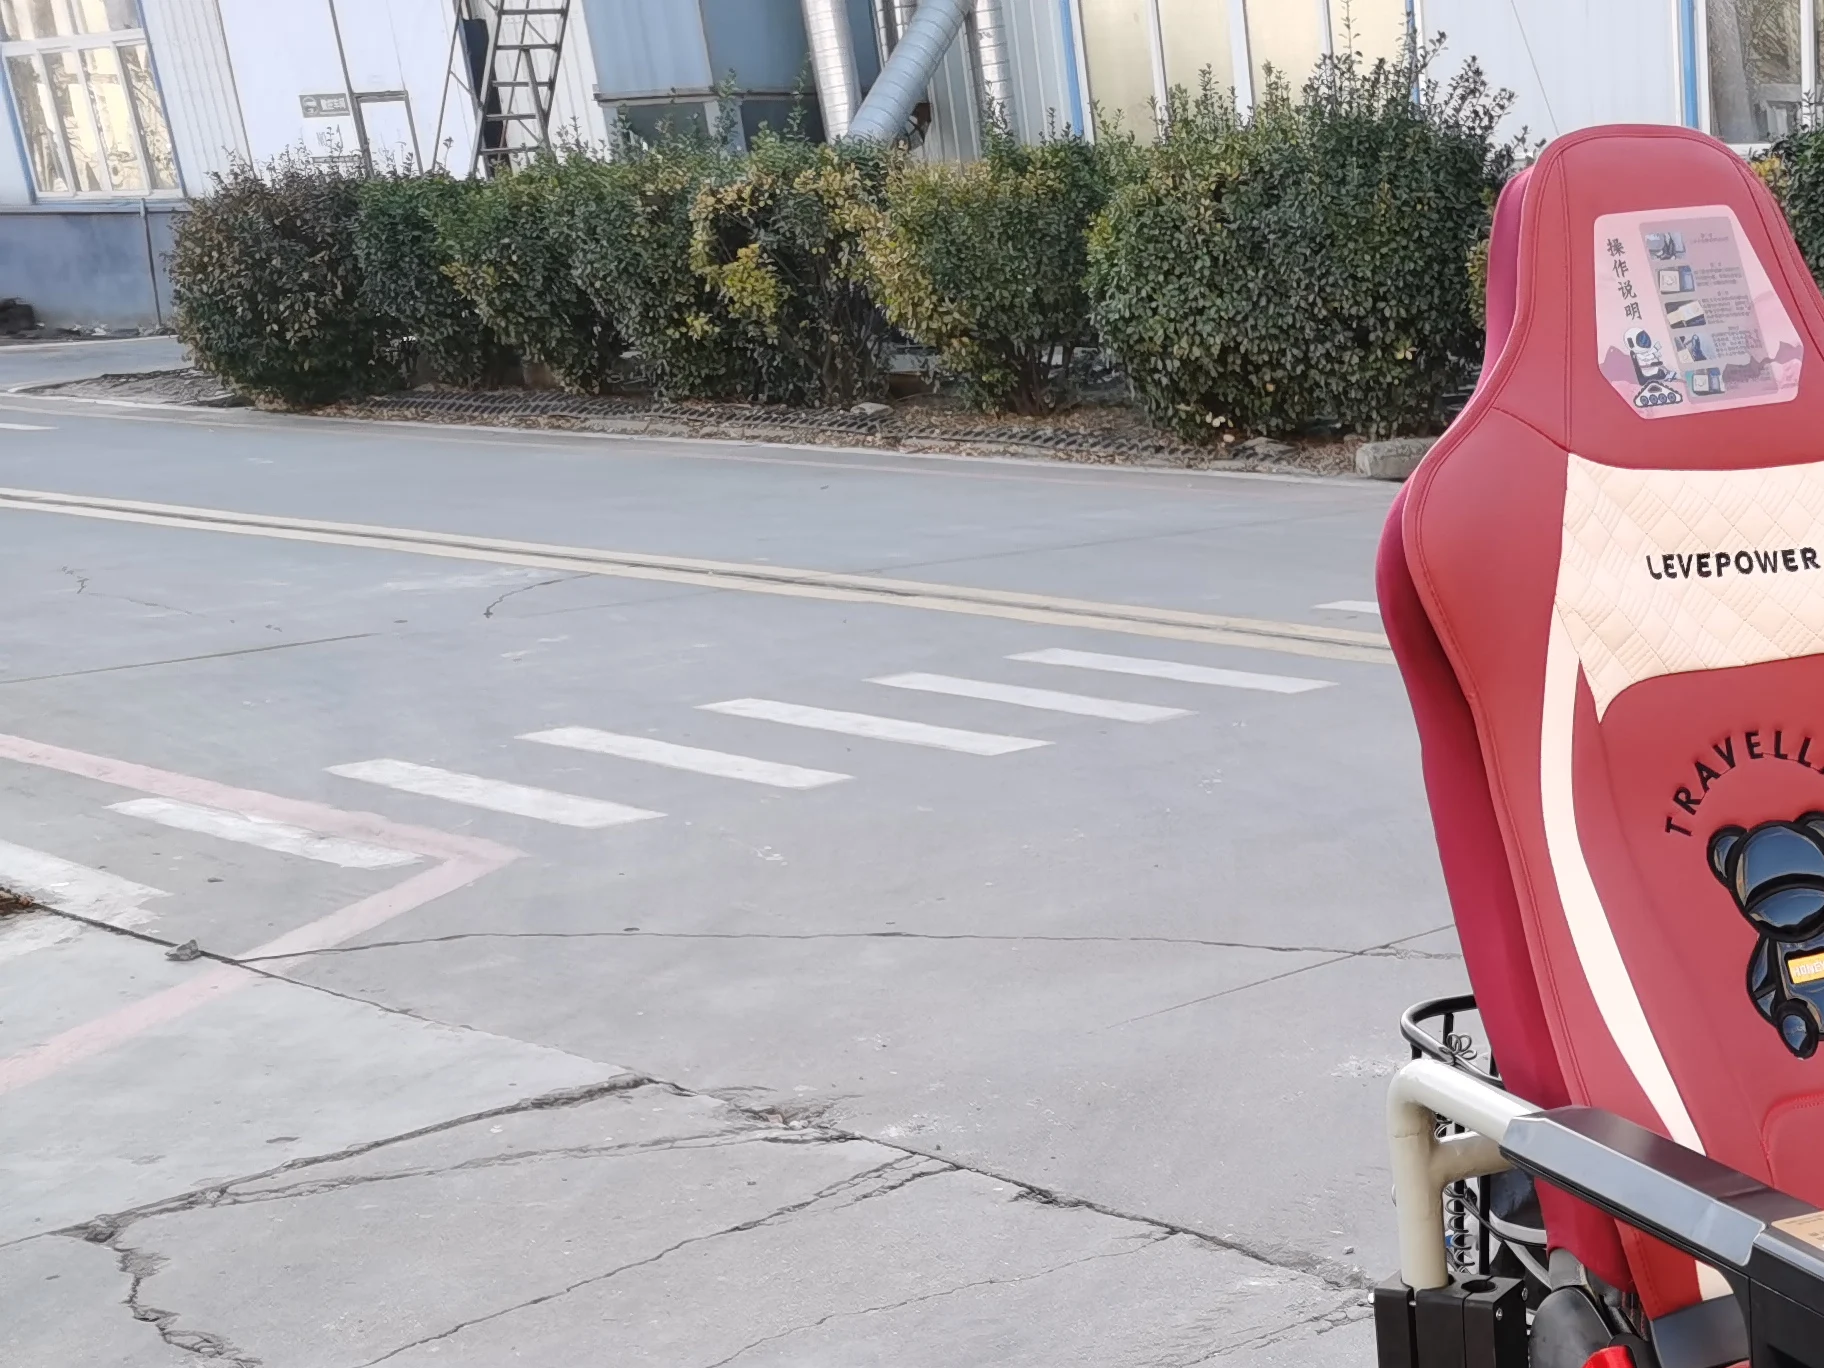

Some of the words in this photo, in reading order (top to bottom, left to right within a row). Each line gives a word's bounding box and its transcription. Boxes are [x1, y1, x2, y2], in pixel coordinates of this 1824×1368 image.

[1606, 238, 1643, 321] 操作说明
[1646, 546, 1822, 581] LEVEPOWER
